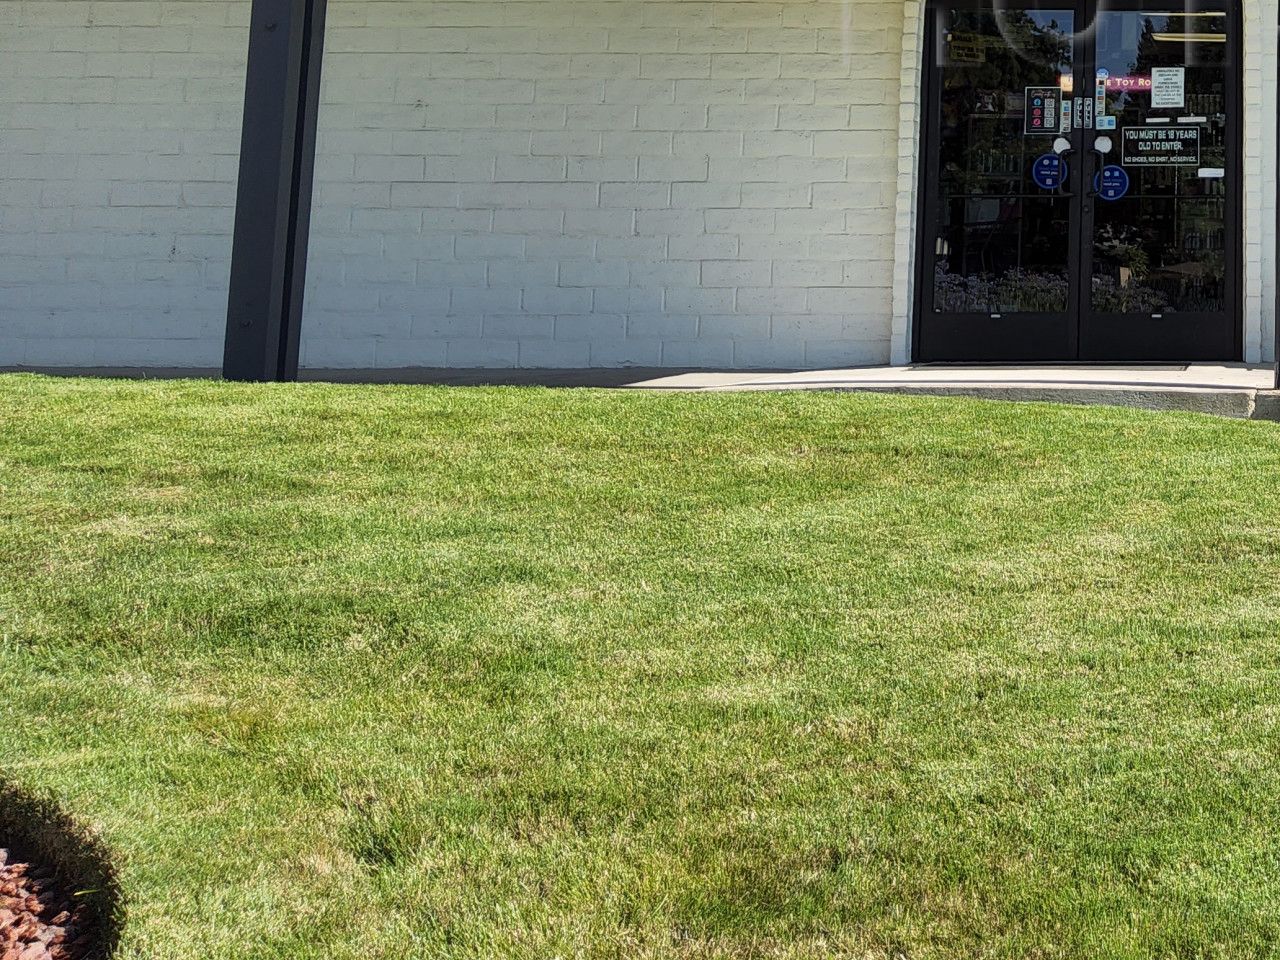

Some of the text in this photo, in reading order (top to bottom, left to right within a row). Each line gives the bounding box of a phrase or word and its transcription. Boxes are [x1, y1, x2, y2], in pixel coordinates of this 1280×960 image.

[1125, 130, 1197, 139] YOU MUST BE 18 YEARS
[1138, 142, 1151, 150] OLD
[1152, 142, 1160, 150] TO
